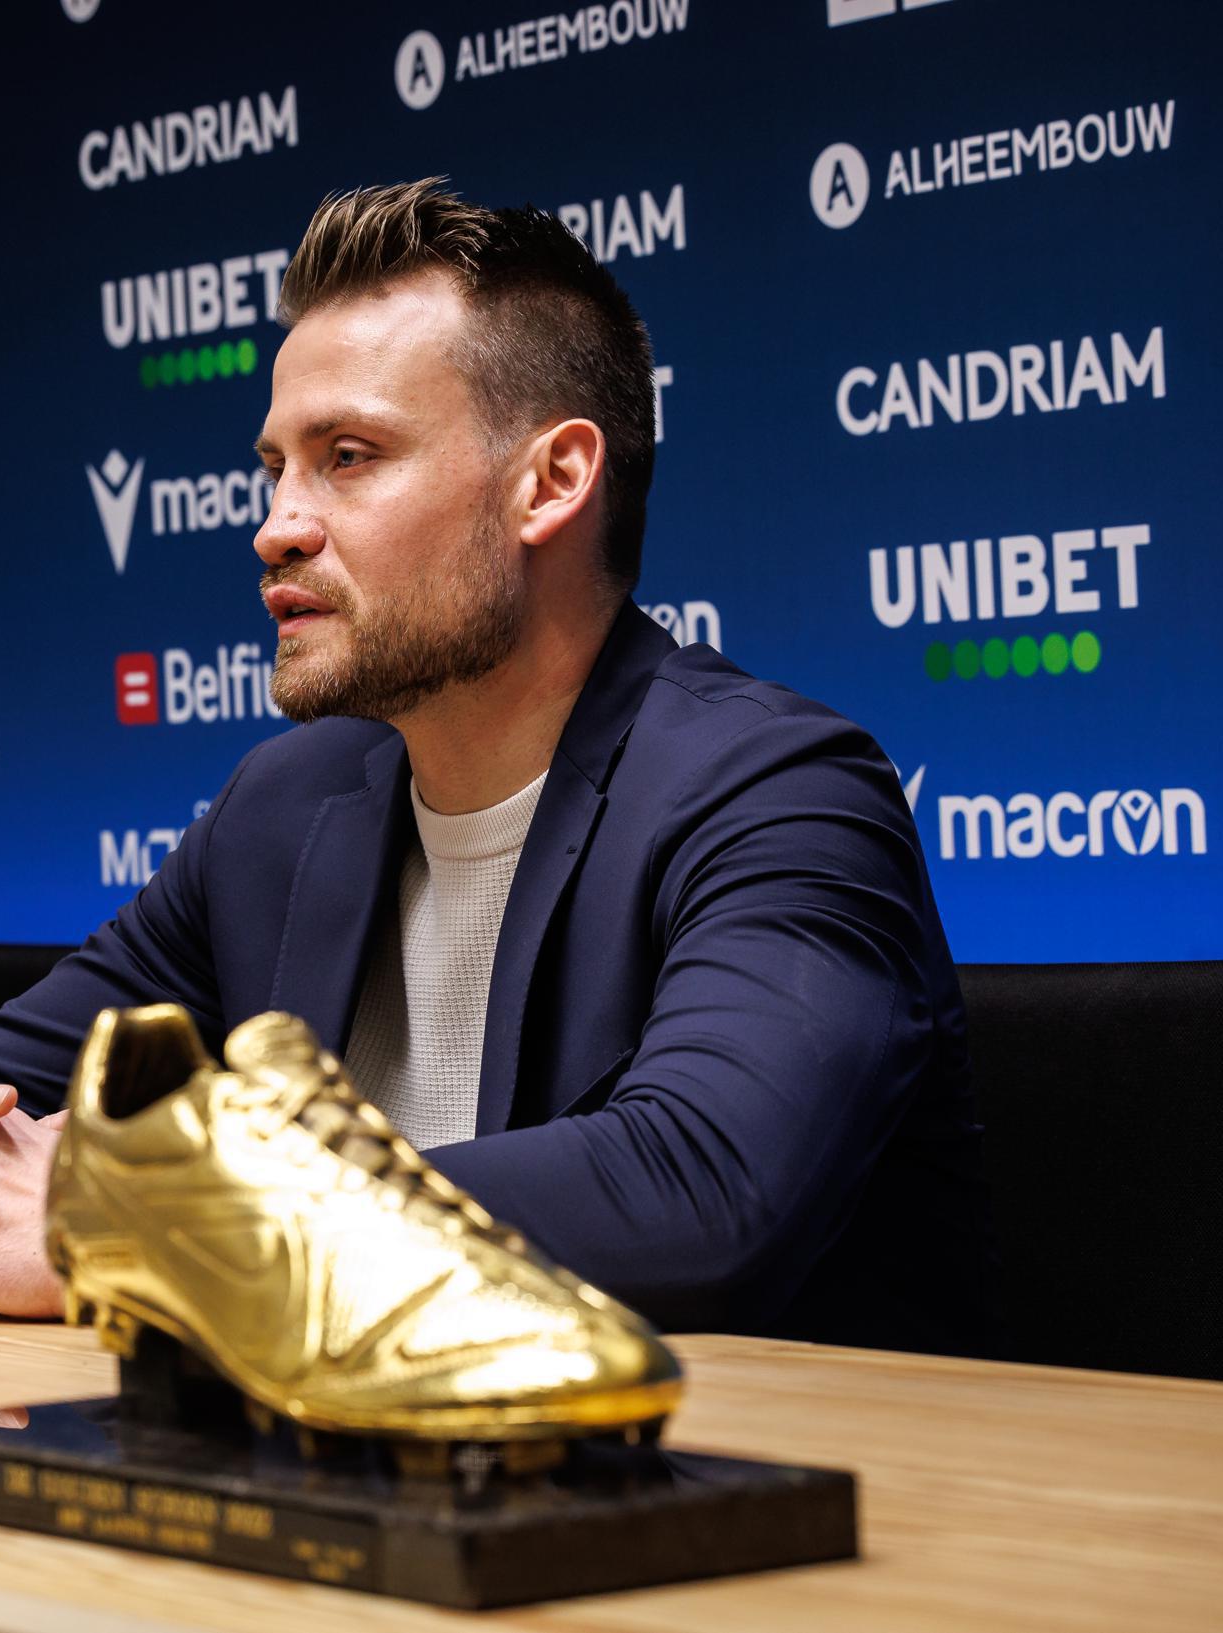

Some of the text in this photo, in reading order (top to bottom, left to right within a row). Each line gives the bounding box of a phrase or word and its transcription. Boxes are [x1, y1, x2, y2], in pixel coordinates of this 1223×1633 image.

[455, 0, 689, 82] ALHEEMBOUW
[79, 85, 298, 190] CANDRIAM
[884, 100, 1176, 199] ALHEEMBOUW
[100, 248, 290, 349] UNIBET
[835, 326, 1167, 437] CANDRIAM
[868, 523, 1152, 629] UNIBET
[938, 788, 1208, 861] macron
